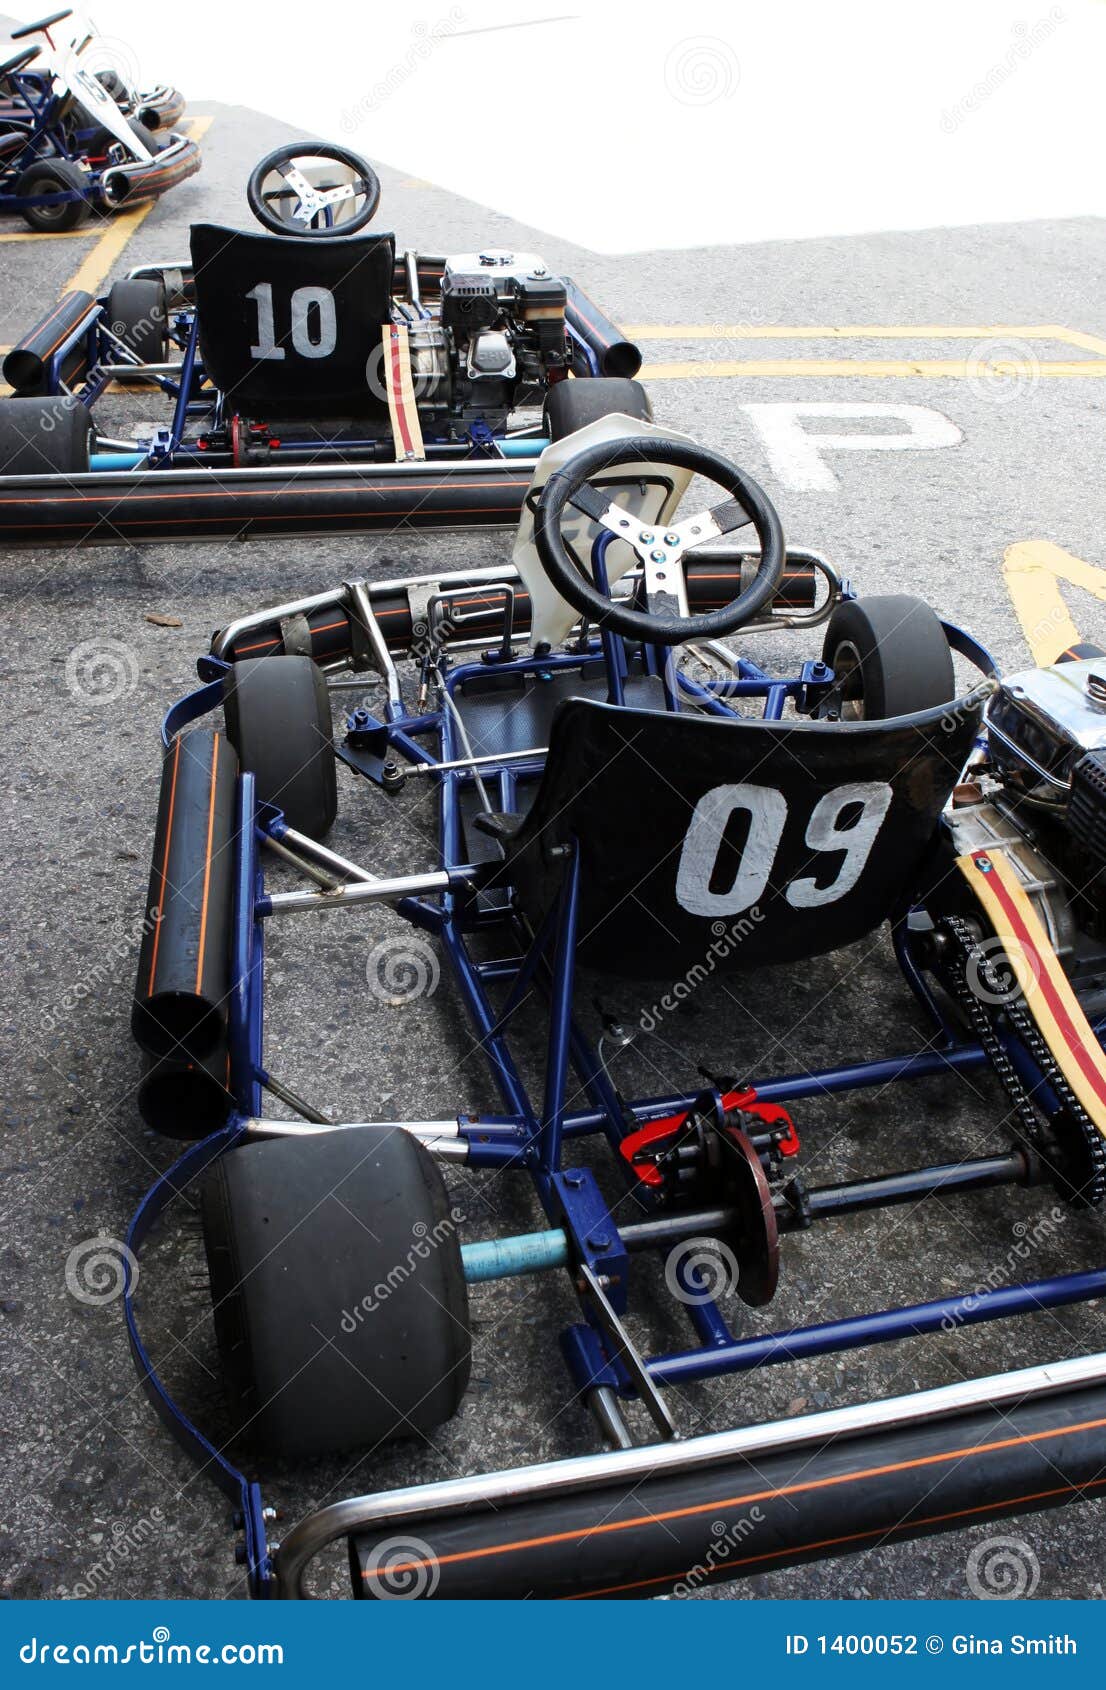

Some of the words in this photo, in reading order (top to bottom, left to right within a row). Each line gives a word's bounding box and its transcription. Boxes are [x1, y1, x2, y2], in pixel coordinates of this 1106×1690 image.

[246, 282, 337, 360] 10
[738, 402, 967, 492] P
[675, 781, 893, 917] 09
